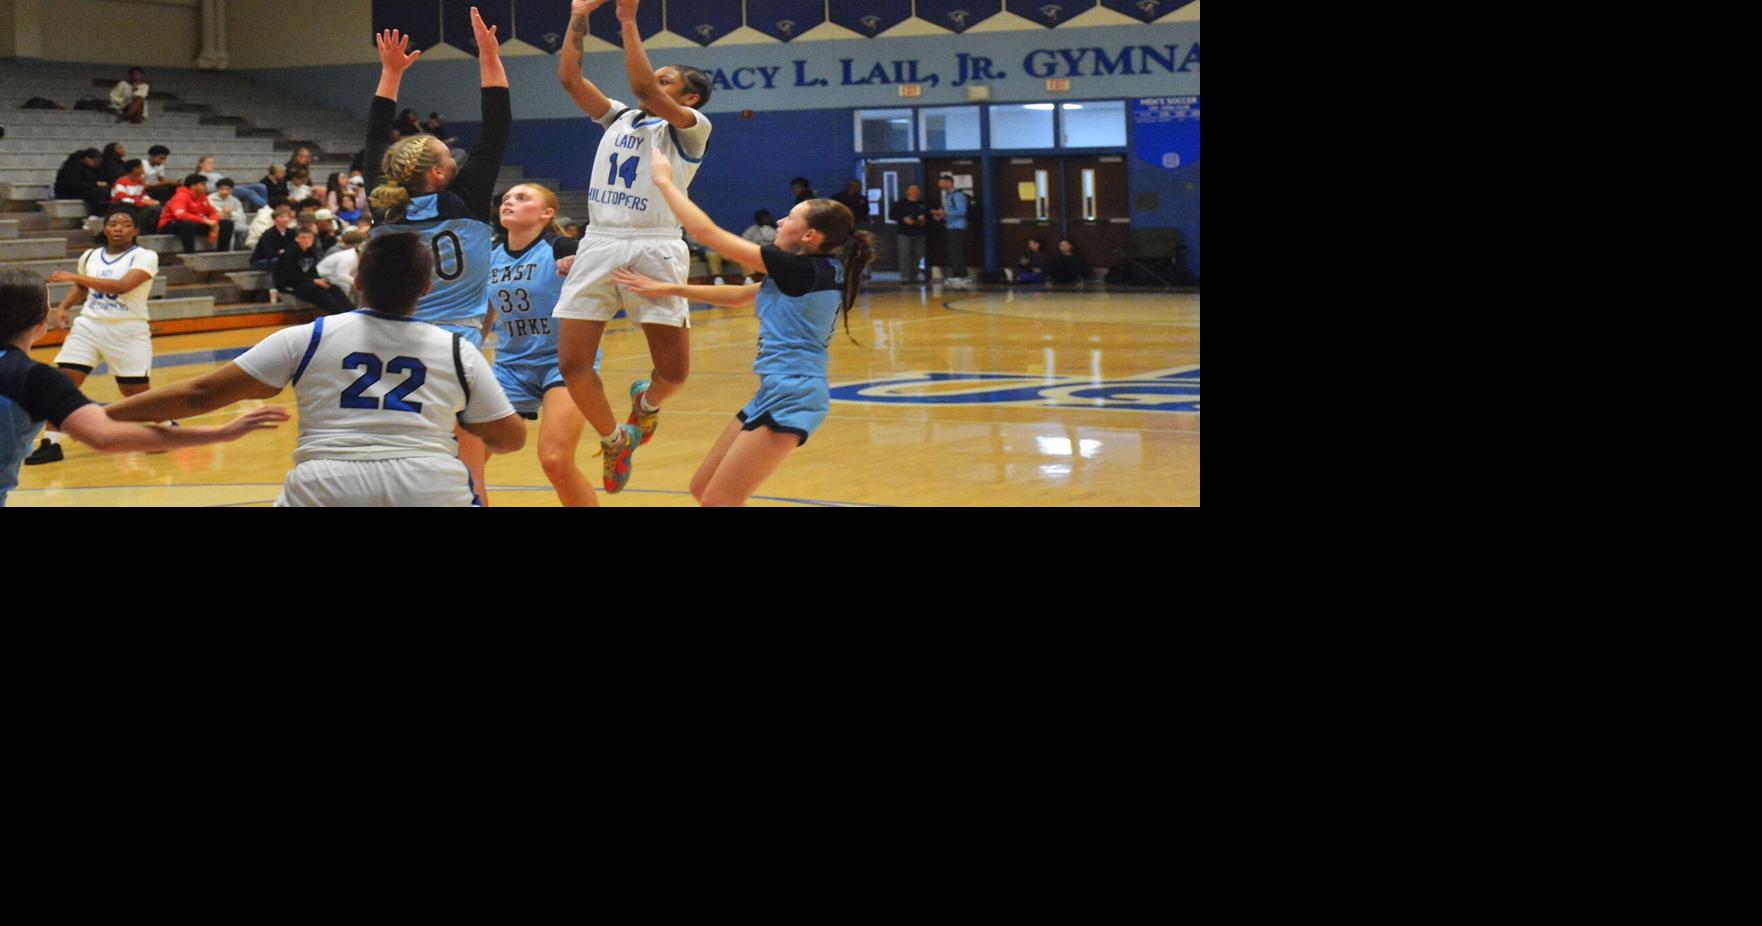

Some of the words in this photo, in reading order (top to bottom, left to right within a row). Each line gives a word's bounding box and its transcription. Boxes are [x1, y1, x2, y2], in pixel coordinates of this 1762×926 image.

[703, 66, 781, 90] ACY
[793, 60, 828, 87] L.
[839, 59, 940, 88] LAIL,
[952, 53, 1007, 87] JR.
[615, 134, 645, 151] LADY
[607, 152, 640, 189] 14
[491, 263, 537, 284] EAST
[498, 288, 530, 313] 33
[339, 351, 428, 414] 22
